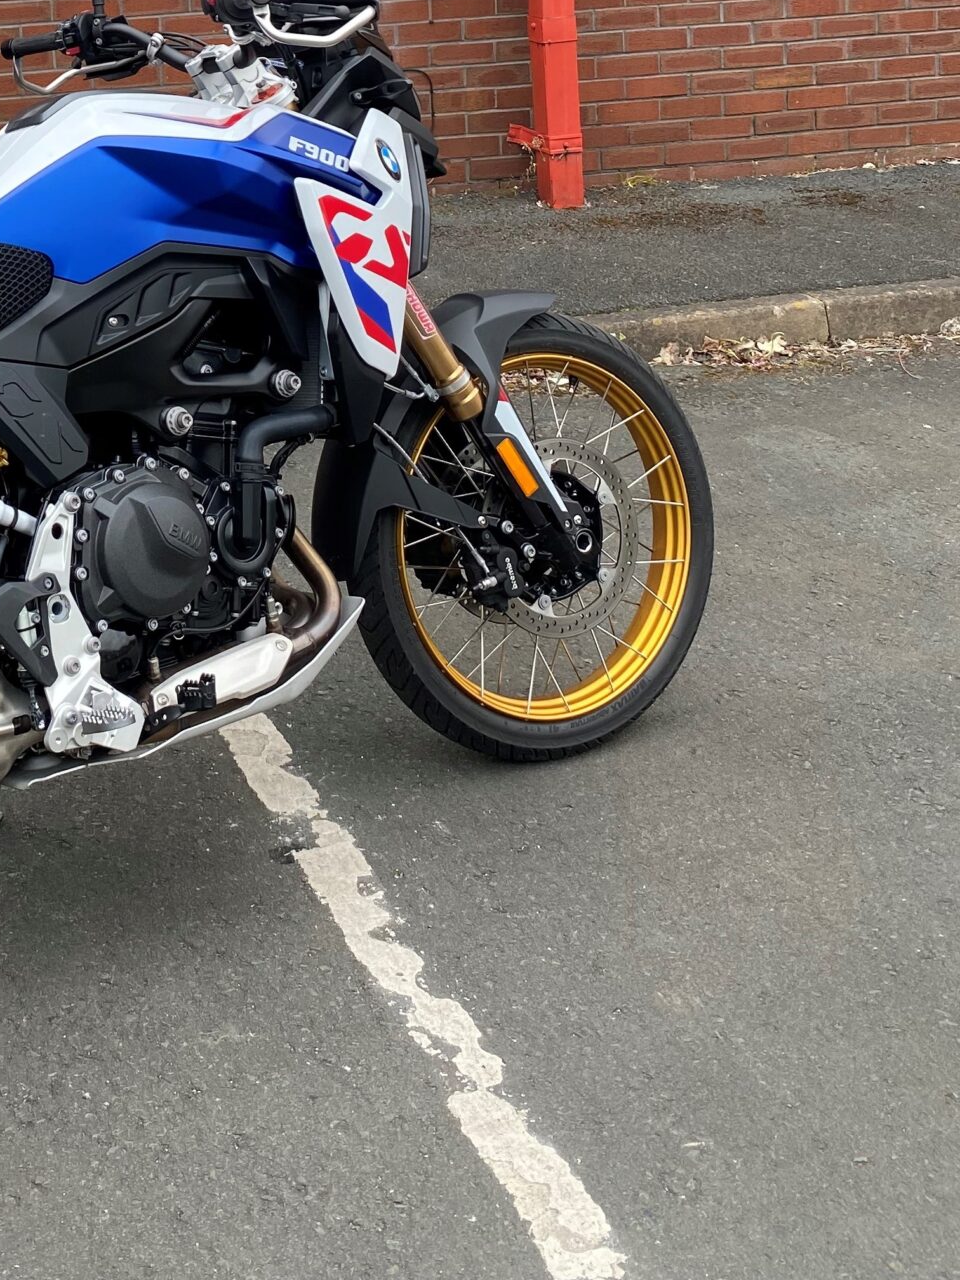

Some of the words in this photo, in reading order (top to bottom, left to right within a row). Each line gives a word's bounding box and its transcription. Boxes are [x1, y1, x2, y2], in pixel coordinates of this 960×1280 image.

[288, 135, 350, 172] F900
[168, 522, 202, 551] BMW
[504, 557, 518, 591] brembo
